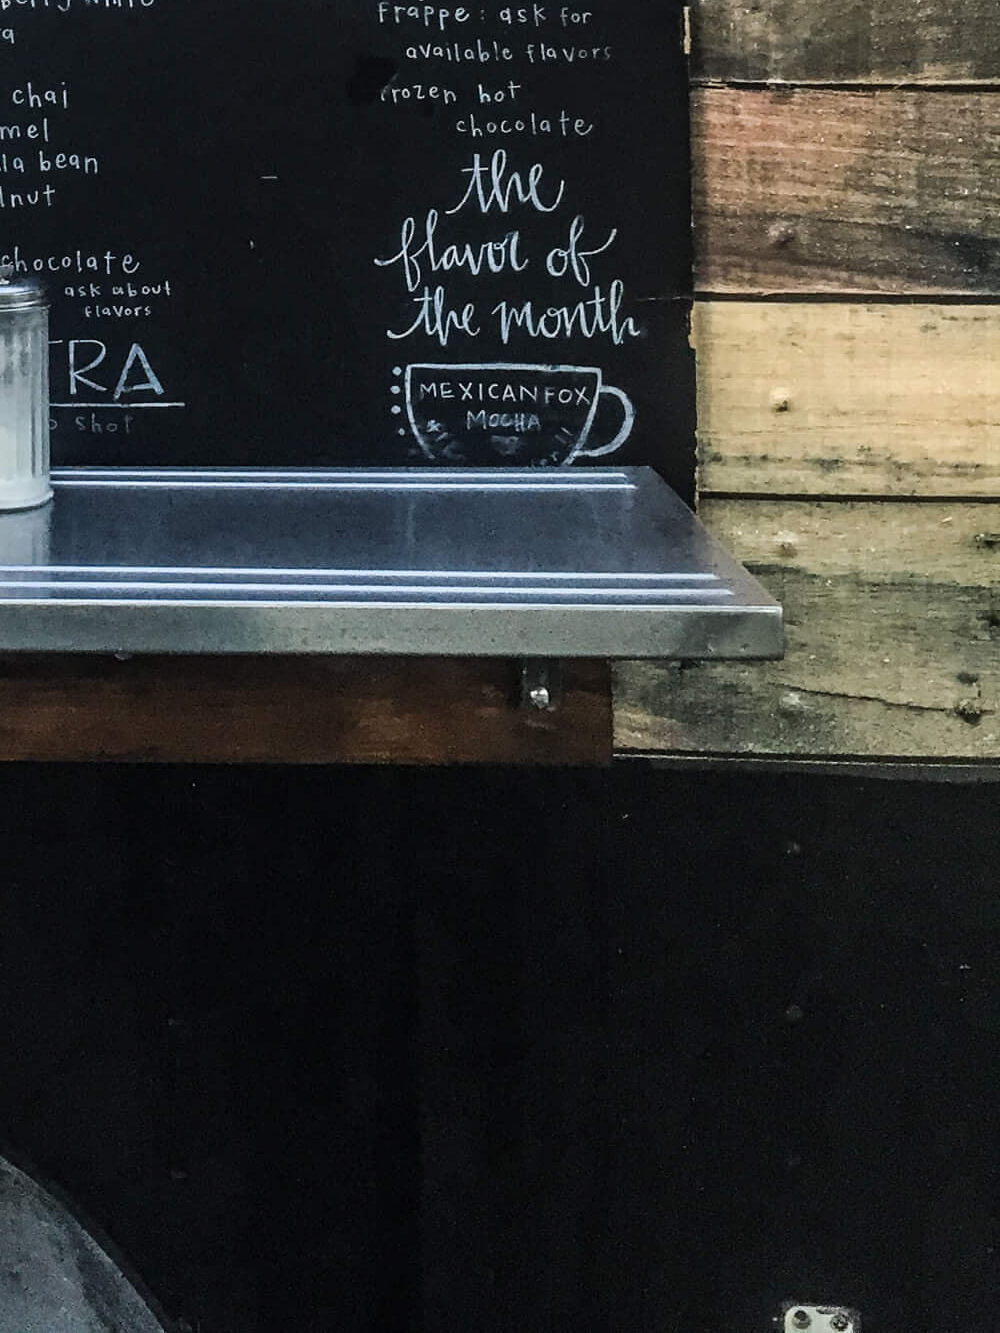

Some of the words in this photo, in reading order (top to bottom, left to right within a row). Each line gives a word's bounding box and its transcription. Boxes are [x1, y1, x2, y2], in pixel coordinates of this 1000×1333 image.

[500, 3, 546, 26] ask
[560, 7, 592, 26] for
[406, 39, 513, 62] available
[526, 42, 612, 62] flavors
[12, 82, 68, 109] chai
[478, 80, 521, 104] hot
[456, 111, 593, 137] chocolate
[39, 151, 98, 174] bean
[445, 149, 565, 214] the
[1, 246, 140, 275] chocolate
[373, 209, 529, 292] flavor
[546, 215, 617, 287] of
[64, 283, 101, 297] ask
[112, 281, 171, 298] about
[386, 285, 480, 346] the
[491, 279, 641, 345] month
[75, 413, 133, 435] shot
